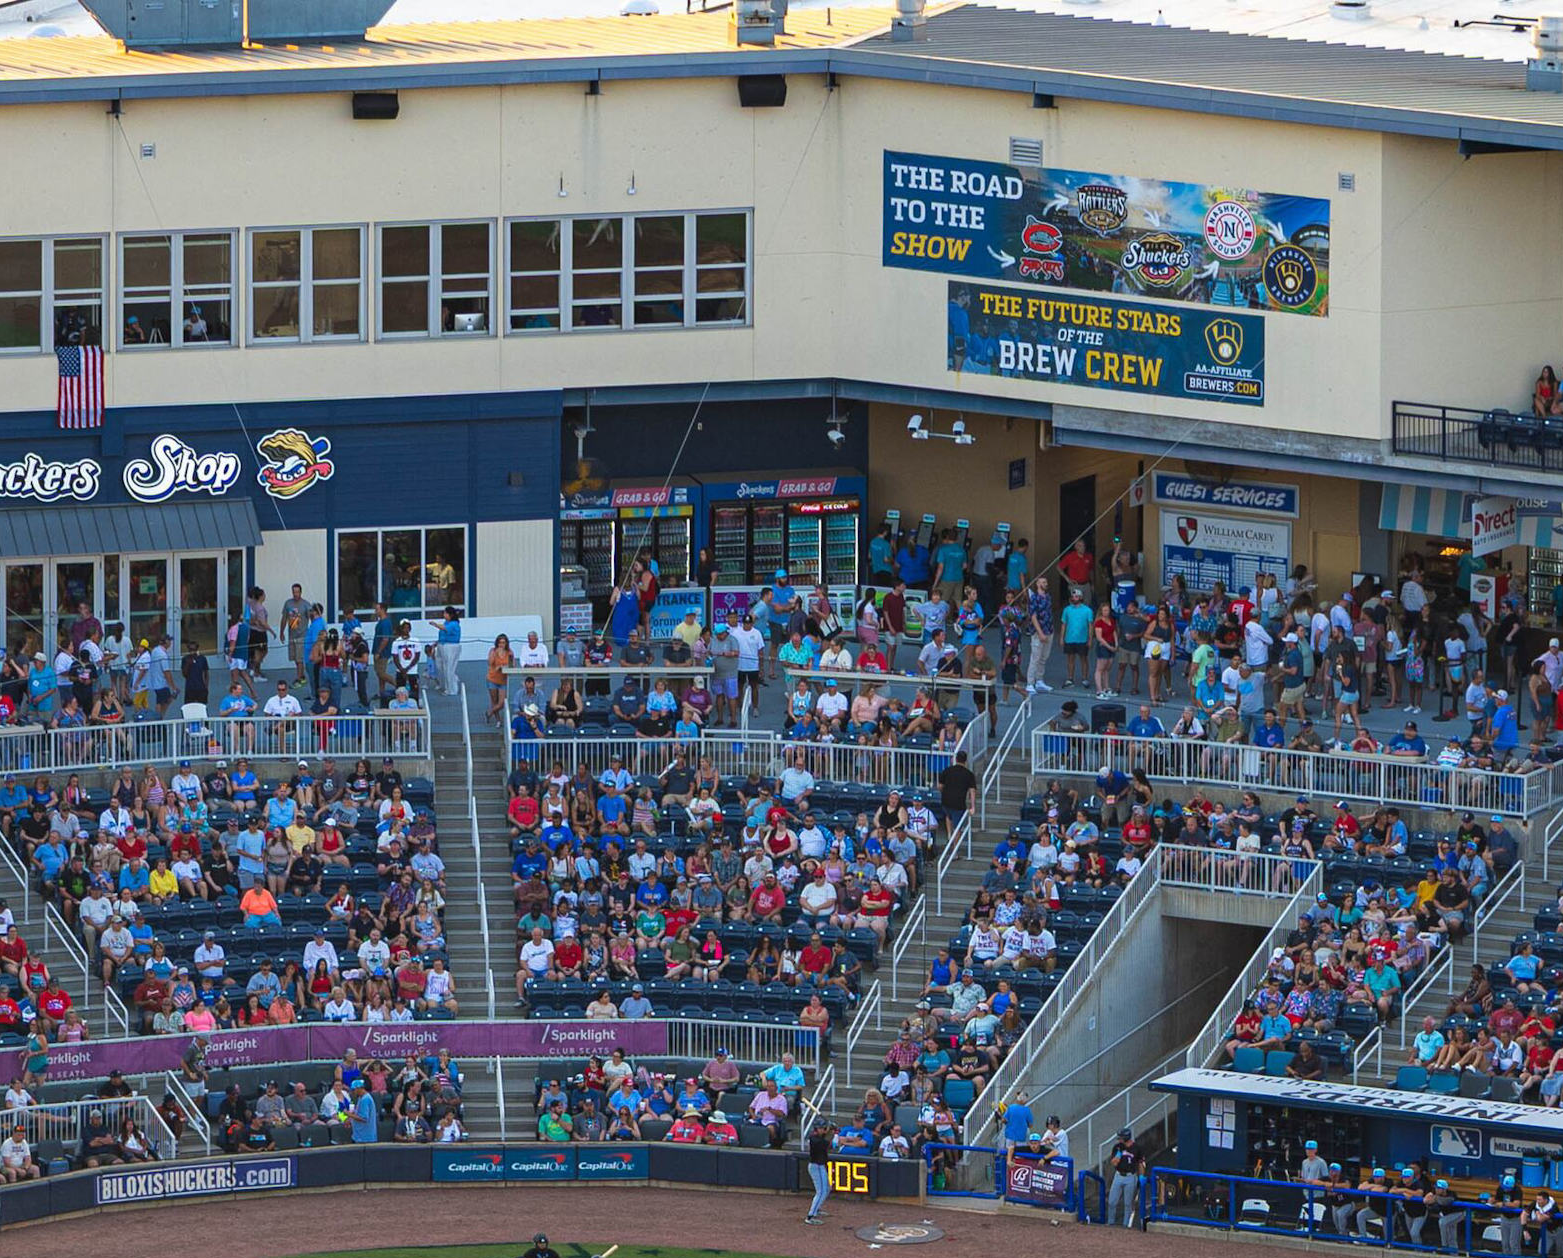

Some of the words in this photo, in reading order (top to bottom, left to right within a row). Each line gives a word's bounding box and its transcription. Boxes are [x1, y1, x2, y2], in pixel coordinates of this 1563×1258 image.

[891, 164, 945, 193] THE
[950, 170, 1024, 201] ROAD
[891, 198, 926, 223] TO
[931, 201, 985, 230] THE
[1078, 192, 1126, 215] RATTLERS
[1207, 204, 1251, 232] NASHVILLE
[891, 232, 972, 261] SHOW
[1121, 243, 1192, 271] Shuckers
[1212, 237, 1249, 258] SOUNDS
[980, 293, 1022, 319] THE
[1027, 300, 1113, 328] FUTURE
[1117, 310, 1182, 337] STARS
[1057, 328, 1073, 343] OF
[1074, 330, 1104, 346] THE
[998, 340, 1076, 377] BREW
[1085, 349, 1163, 387] CREW
[1195, 363, 1254, 378] AA-AFFILIATE
[1189, 376, 1258, 395] BREWERS.COM
[123, 434, 241, 503] Shop
[615, 494, 641, 505] GRAB
[642, 492, 650, 503] &
[650, 491, 666, 502] GO
[781, 483, 806, 494] GRAB
[807, 482, 816, 492] &
[816, 481, 832, 492] GO
[1212, 486, 1287, 508] SERVICES
[1474, 504, 1516, 536] Direct
[1203, 524, 1245, 539] WILLIAM
[1245, 529, 1275, 543] CAREY
[204, 1038, 257, 1054] parklight
[372, 1030, 438, 1045] Sparklight
[551, 1028, 616, 1043] Sparklight
[47, 1051, 91, 1066] arklight
[1280, 1088, 1530, 1122] INJURED?
[101, 1164, 289, 1200] BILOXISHUCKERS.com
